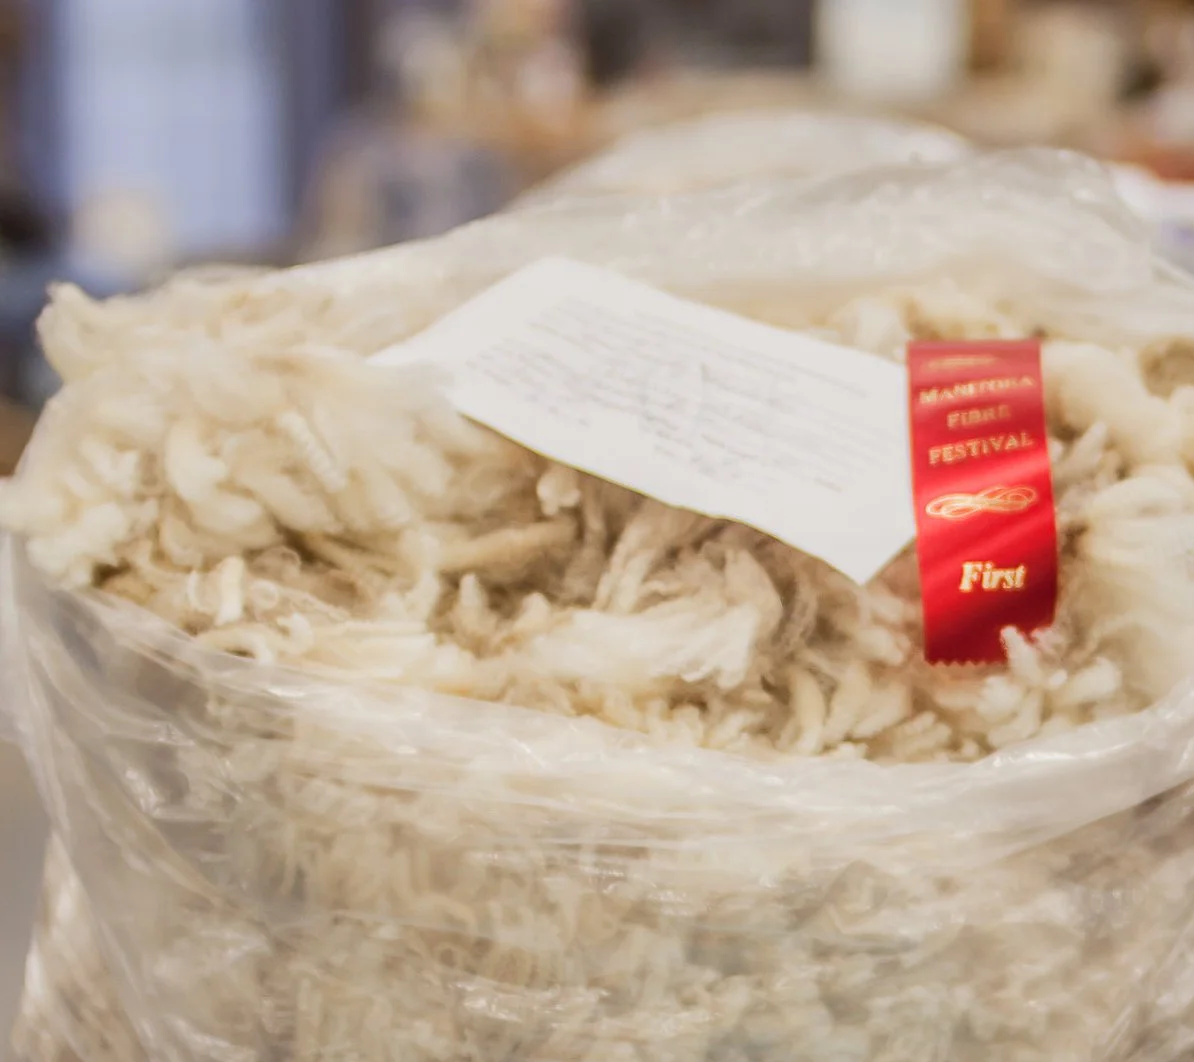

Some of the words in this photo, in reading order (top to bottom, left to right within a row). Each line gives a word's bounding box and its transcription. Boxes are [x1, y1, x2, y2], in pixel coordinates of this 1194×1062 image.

[919, 375, 1035, 404] MANITOBA
[947, 404, 1011, 429] FIBRE
[928, 432, 1034, 466] FESTIVAL
[959, 561, 1027, 593] First
